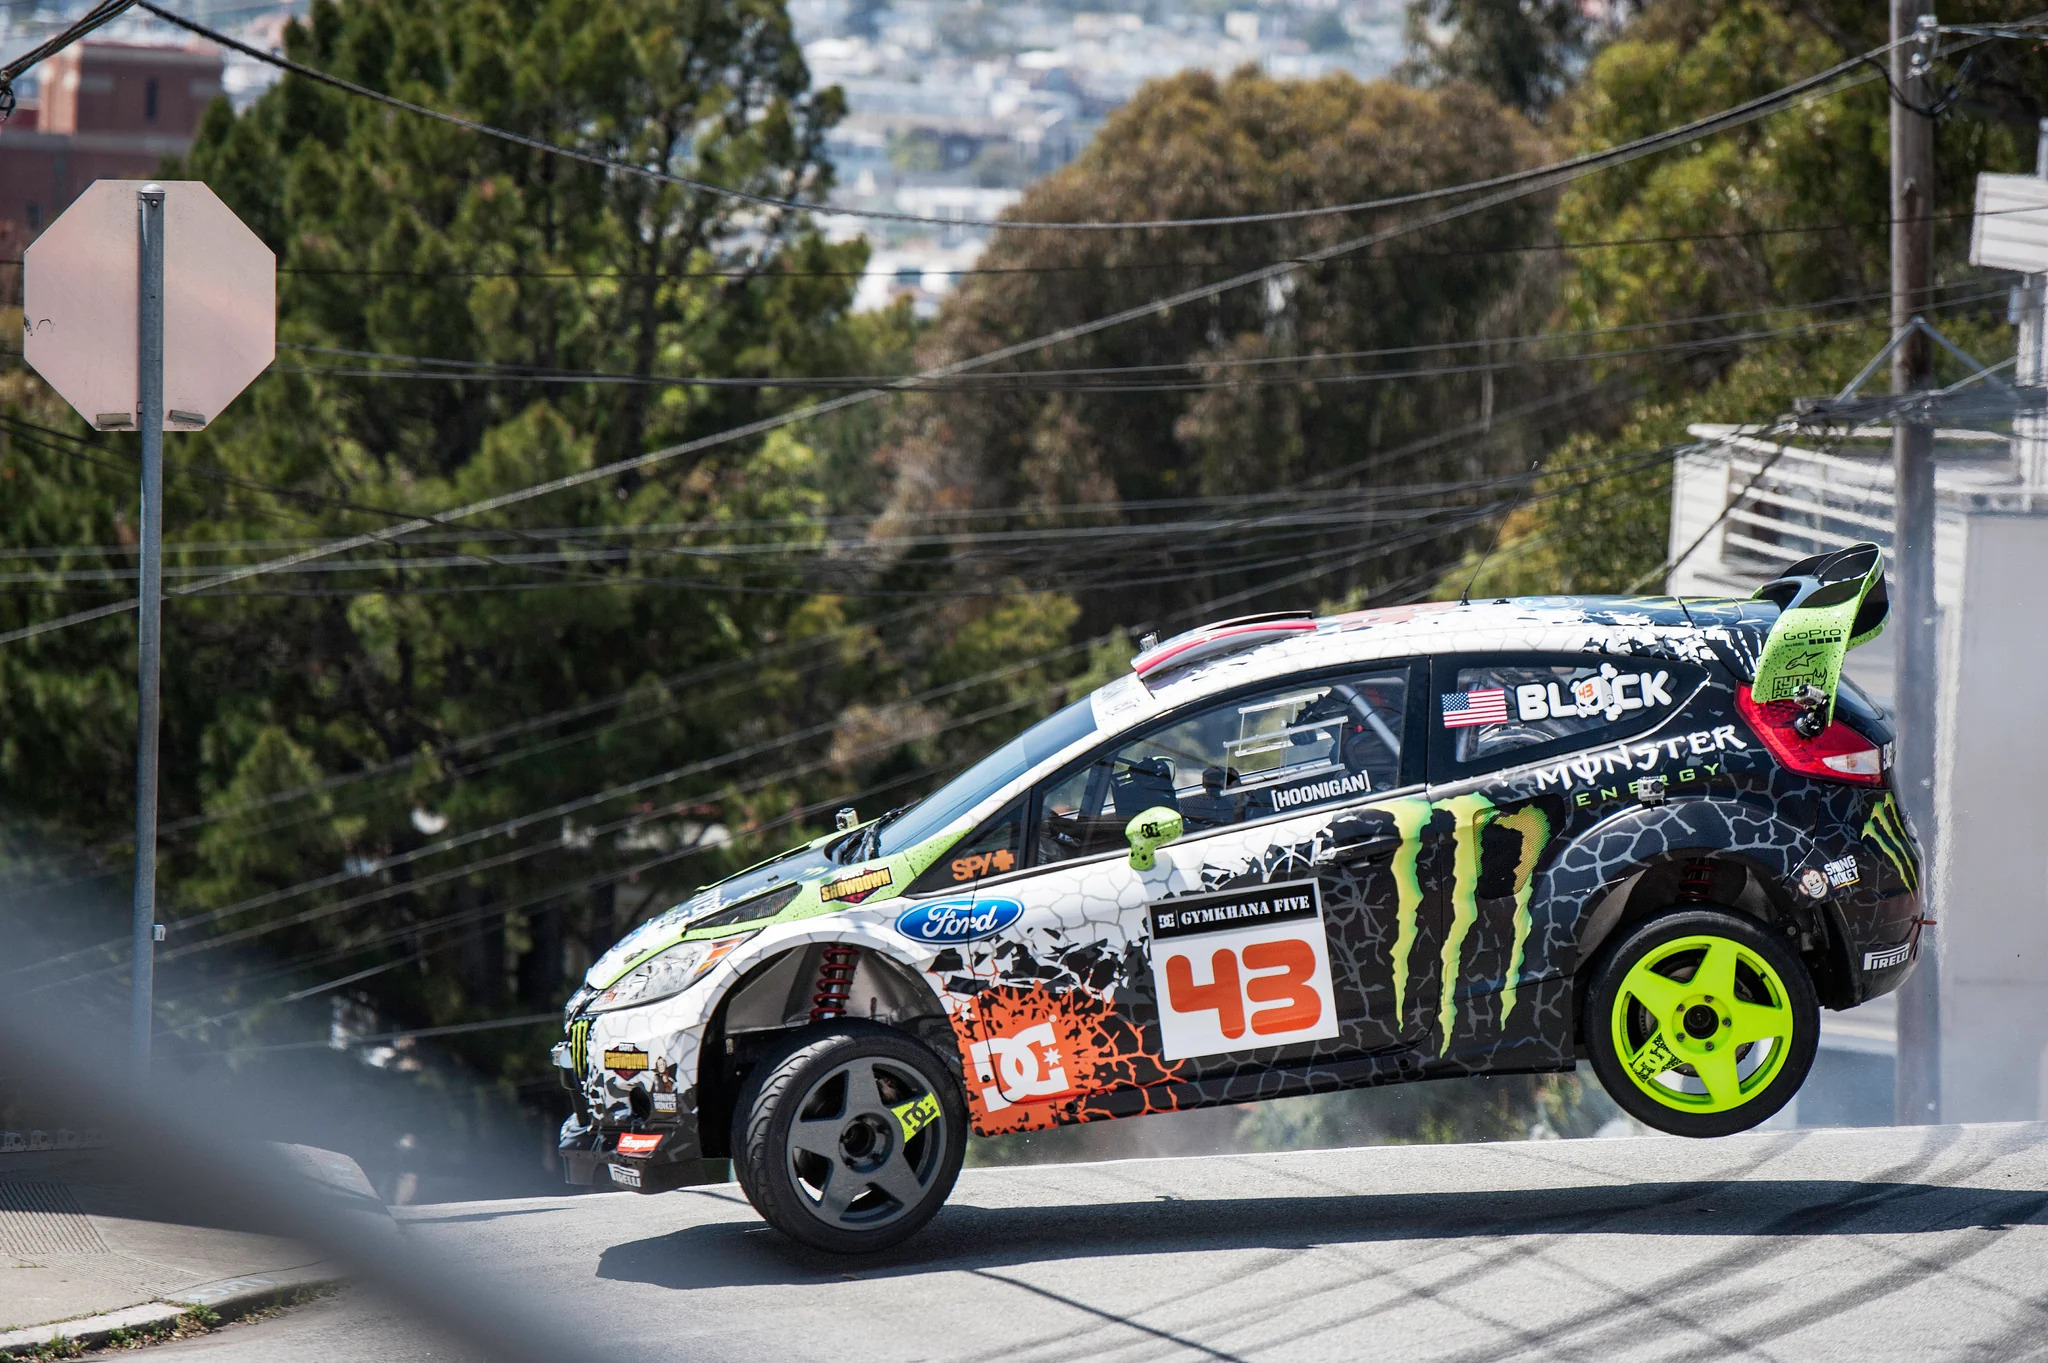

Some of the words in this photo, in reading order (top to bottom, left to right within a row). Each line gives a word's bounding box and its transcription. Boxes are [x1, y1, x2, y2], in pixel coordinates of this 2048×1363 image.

[1784, 629, 1841, 640] GoPro
[1535, 724, 1748, 790] MONSTER
[821, 868, 892, 901] SHOWDOWN
[921, 903, 998, 938] Ford
[1180, 901, 1271, 926] GYMKHANA
[1273, 895, 1310, 912] FIVE
[1863, 943, 1911, 971] PIRELLI
[1166, 939, 1322, 1039] 43
[969, 1022, 1070, 1113] DC
